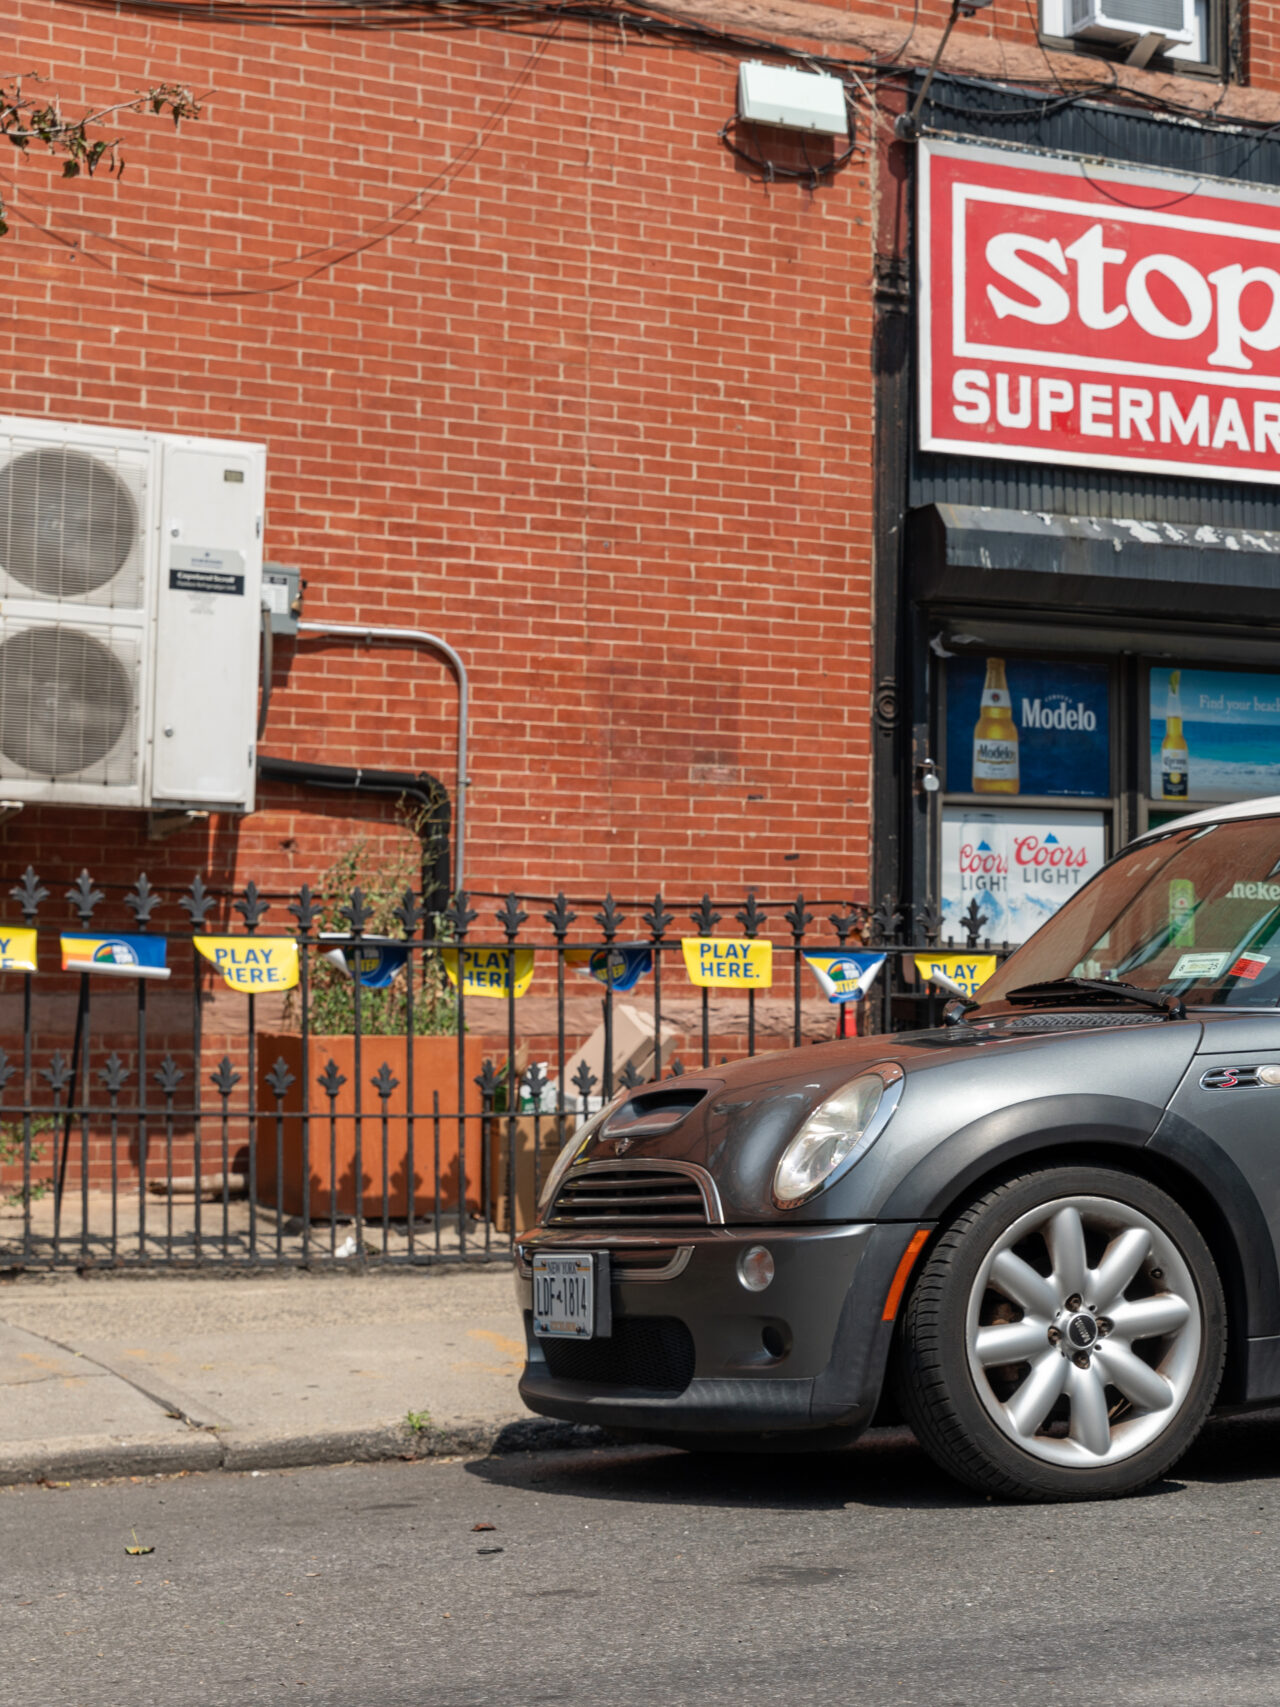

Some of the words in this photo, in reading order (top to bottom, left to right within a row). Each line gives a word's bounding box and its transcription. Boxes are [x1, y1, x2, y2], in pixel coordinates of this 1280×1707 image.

[1200, 694, 1224, 709] Find
[1226, 699, 1251, 714] your
[1021, 698, 1097, 732] Modelo
[1014, 835, 1088, 868] Coors
[1023, 867, 1081, 885] LIGHT
[215, 948, 273, 965] PLAY
[700, 943, 751, 959] PLAY
[701, 962, 760, 978] HERE.
